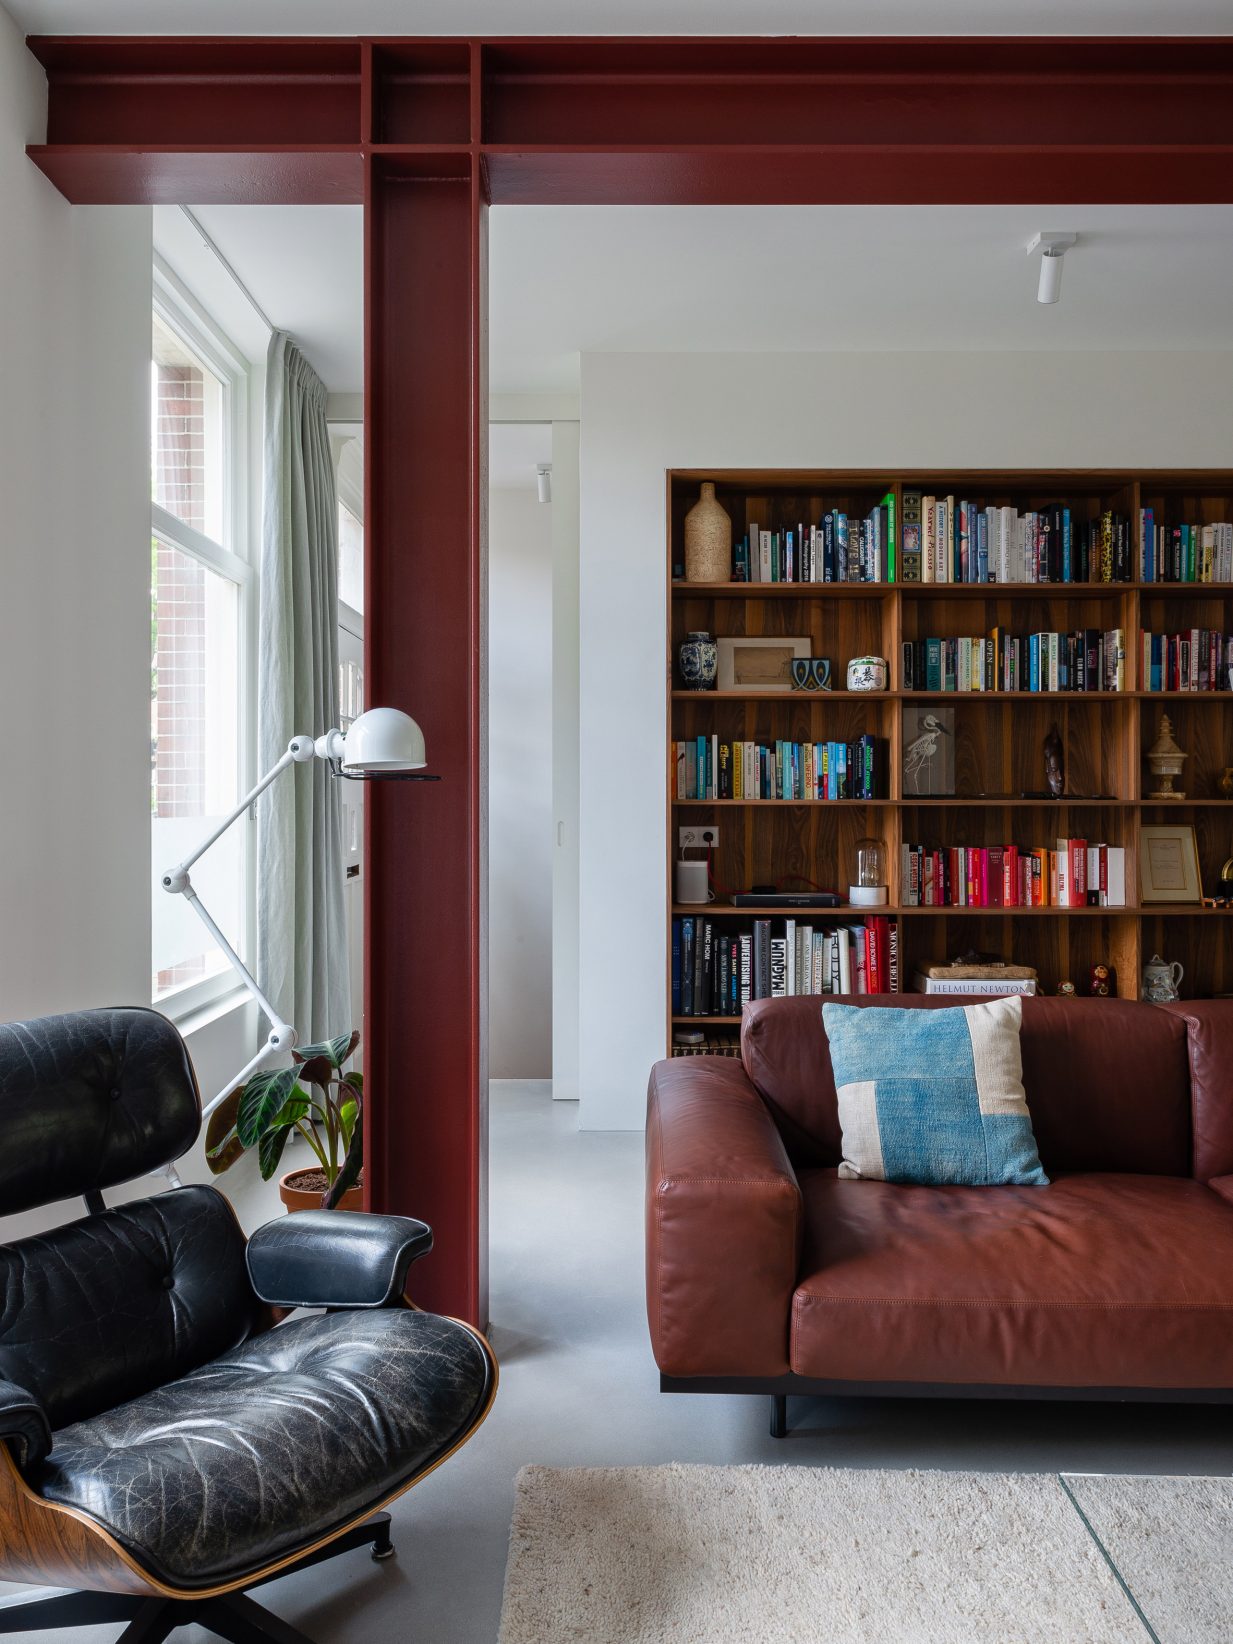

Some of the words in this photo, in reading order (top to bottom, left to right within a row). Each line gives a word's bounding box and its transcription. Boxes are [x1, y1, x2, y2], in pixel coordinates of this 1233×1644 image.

[986, 641, 994, 663] OPEN
[741, 939, 751, 984] ADVERTISING
[889, 930, 897, 963] MONICA
[772, 942, 784, 990] MAGNUM
[933, 984, 976, 993] HELMUT
[980, 985, 1026, 993] NEWTON
